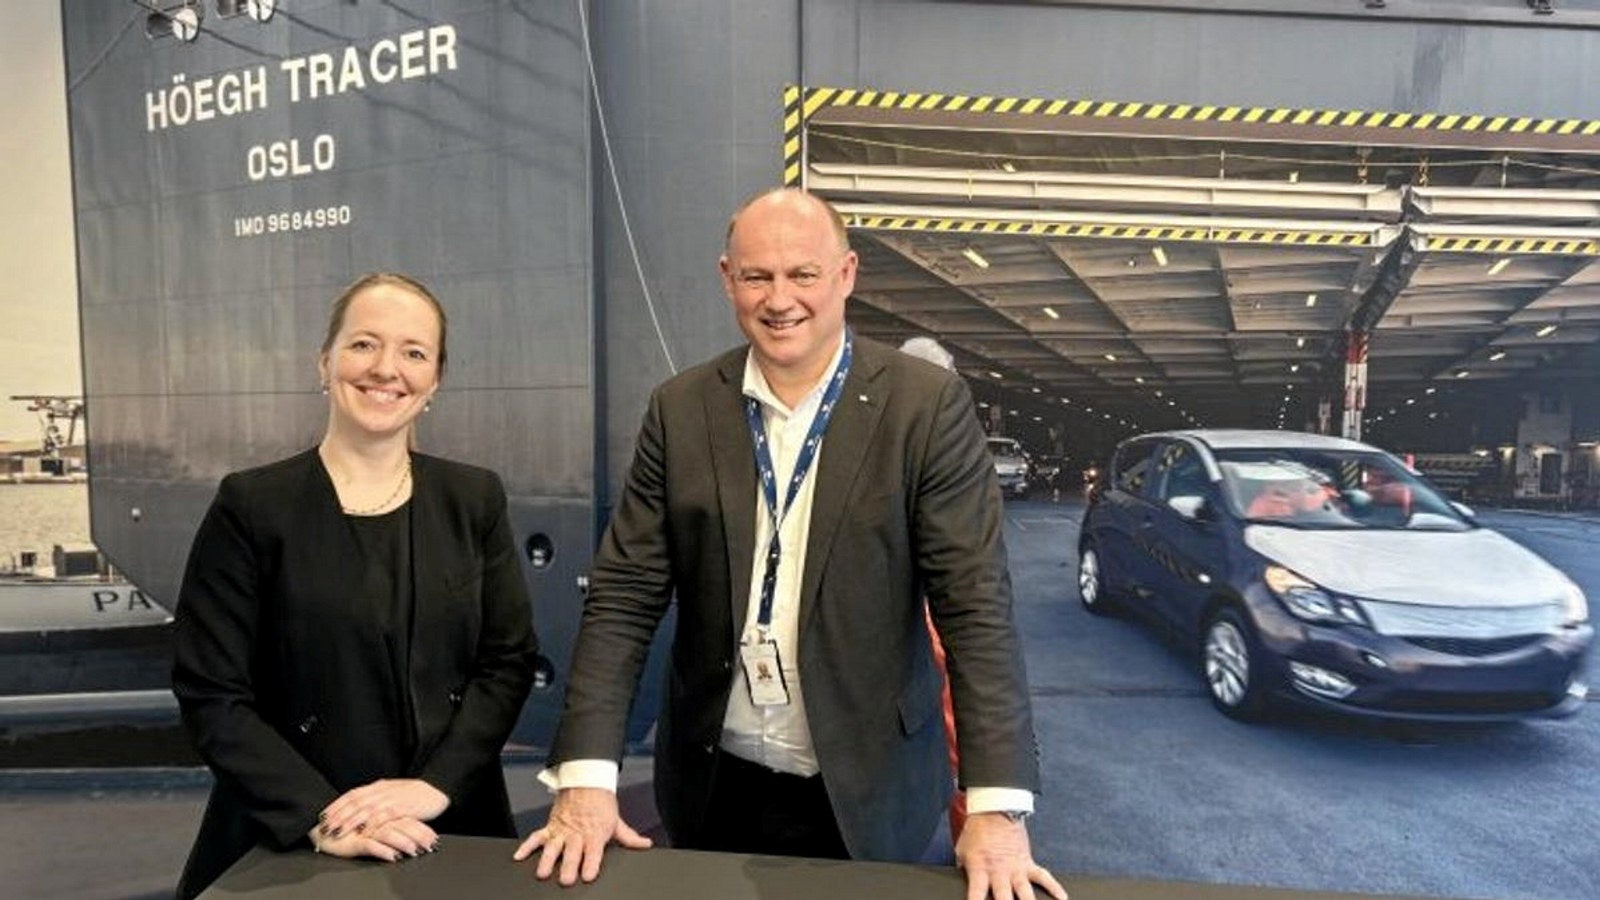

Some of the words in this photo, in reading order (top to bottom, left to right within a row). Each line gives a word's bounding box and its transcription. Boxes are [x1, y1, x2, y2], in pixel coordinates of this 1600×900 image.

[146, 66, 267, 131] HÖEGH
[281, 25, 458, 102] TRACER
[247, 134, 335, 181] OSLO
[235, 214, 264, 237] IMO
[267, 205, 351, 233] 9684990
